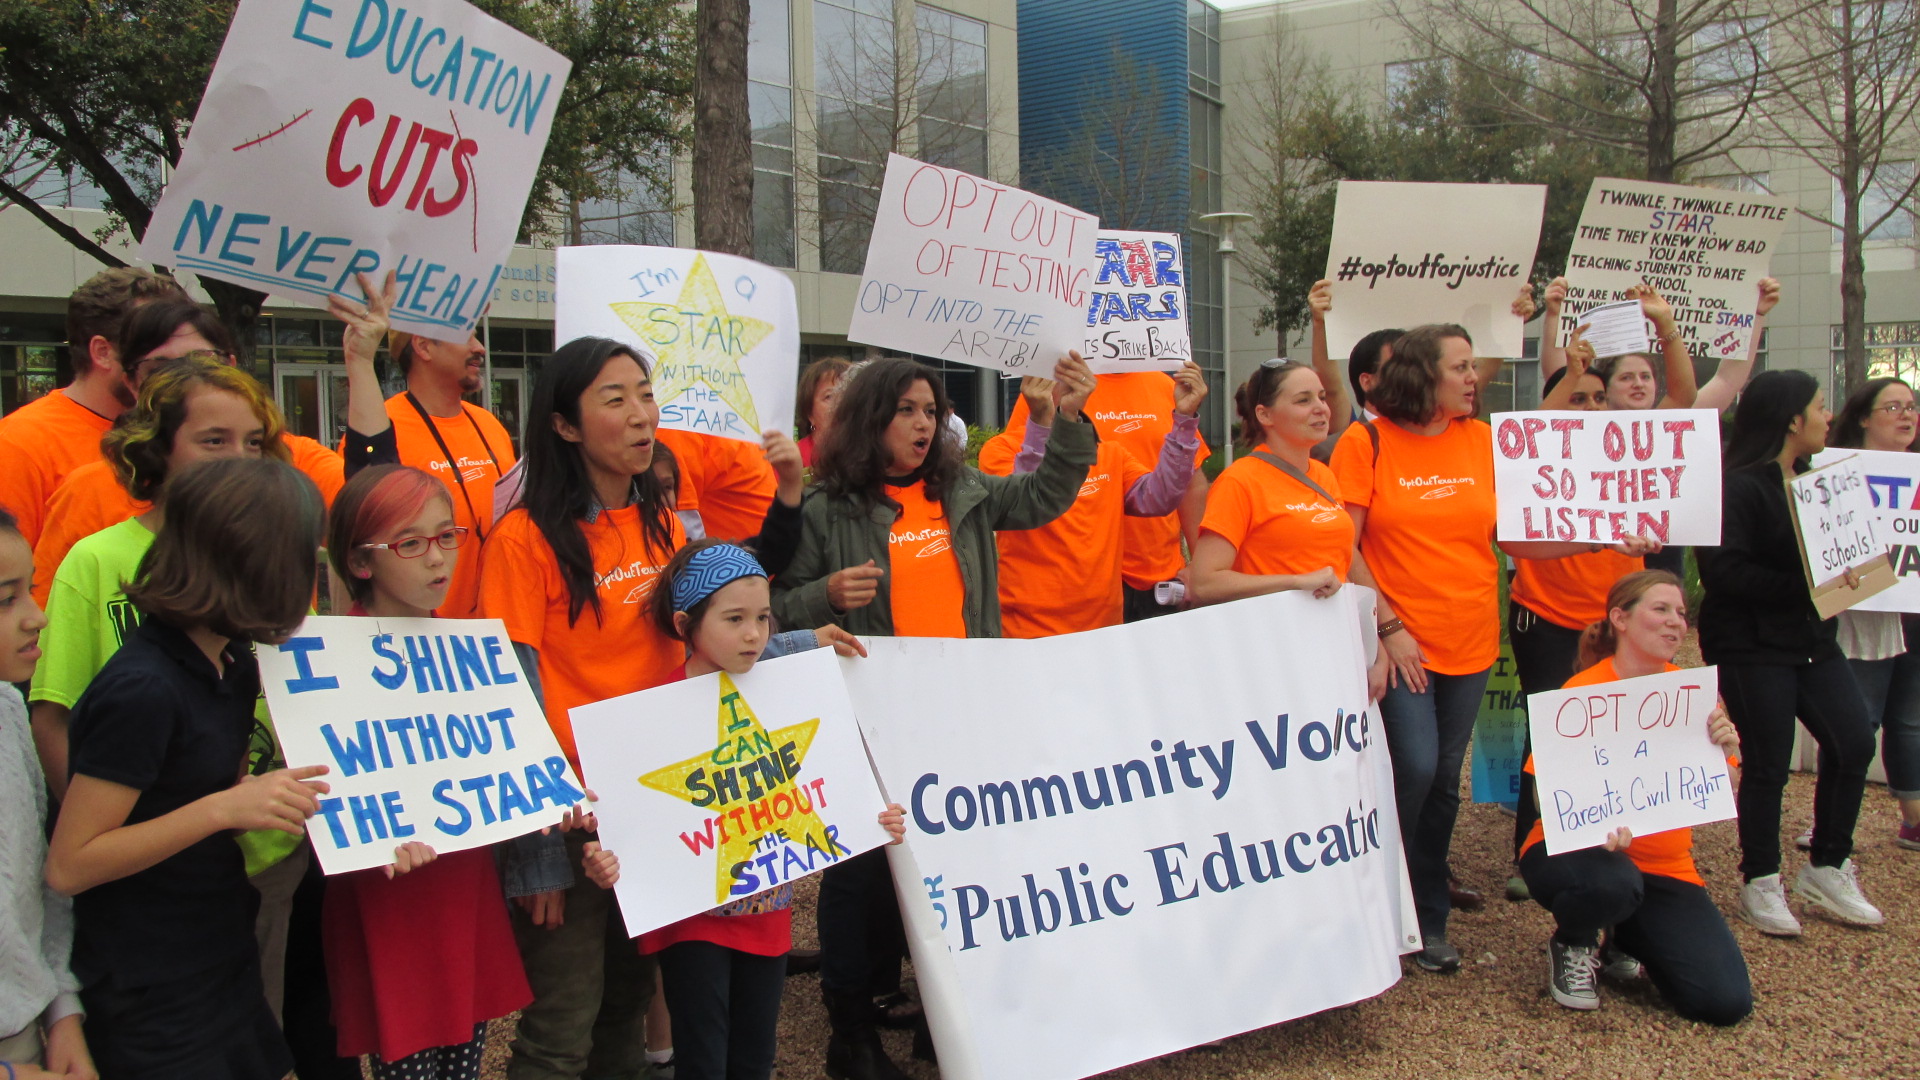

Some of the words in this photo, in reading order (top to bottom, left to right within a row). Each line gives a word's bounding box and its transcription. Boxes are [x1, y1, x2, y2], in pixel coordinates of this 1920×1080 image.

[293, 0, 551, 136] EDUCATION
[326, 97, 478, 218] CUTS
[903, 165, 1007, 234] OPT
[1010, 199, 1087, 258] OUT
[1737, 203, 1788, 221] LITTLE
[1580, 226, 1612, 242] TIME
[1616, 229, 1648, 245] THEY
[1651, 232, 1697, 249] KNEW
[1697, 236, 1734, 251] HOW
[1735, 240, 1767, 255] BAD
[1649, 247, 1677, 262] YOU
[173, 198, 381, 301] NEVER
[395, 254, 502, 331] HEAL!
[629, 267, 679, 299] I'm
[916, 239, 967, 278] OF
[974, 248, 1090, 308] TESTING
[1337, 252, 1520, 290] #optoutforjustice
[1571, 254, 1632, 272] TEACHING
[1634, 260, 1692, 277] STUDENTS
[1697, 265, 1713, 279] TO
[1713, 267, 1747, 282] HATE
[511, 288, 557, 303] SCH
[860, 280, 928, 319] OPT
[925, 296, 983, 324] INTO
[993, 308, 1044, 337] THE
[1563, 300, 1607, 315] TWIN
[1673, 309, 1714, 324] LITTLE
[1715, 312, 1755, 328] STAAR
[1565, 287, 1586, 299] YOU
[1588, 289, 1608, 300] ARE
[1612, 290, 1628, 301] NO
[1662, 294, 1691, 307] SEFUL
[648, 307, 748, 357] STAR
[1102, 331, 1148, 359] STRIKE
[1146, 326, 1190, 358] BACK
[1713, 331, 1735, 347] OPT
[1721, 340, 1741, 356] OUT
[661, 363, 745, 389] WITHOUT
[681, 387, 722, 402] THE
[659, 404, 745, 434] STAAR
[1497, 418, 1584, 459] OPT
[1603, 419, 1696, 462] OUT
[1399, 475, 1475, 490] OptOutTexas.org
[1532, 464, 1577, 501] SO
[1591, 465, 1687, 504] THEY
[1523, 506, 1670, 544] LISTEN
[1820, 517, 1831, 535] to
[1836, 510, 1855, 528] our
[1822, 521, 1878, 571] schools!
[278, 636, 340, 695] I
[371, 634, 519, 694] SHINE
[721, 691, 751, 733] I
[1555, 693, 1627, 738] OPT
[1638, 684, 1701, 731] OUT
[319, 707, 517, 778] WITHOUT
[711, 728, 774, 765] CAN
[1594, 745, 1609, 766] is
[1633, 740, 1648, 759] A
[685, 740, 802, 807] SHINE
[911, 738, 1235, 835] Community
[1630, 771, 1669, 811] Civil
[312, 790, 416, 850] THE
[432, 755, 586, 837] STAAR
[679, 777, 829, 857] WITHOUT
[729, 824, 852, 895] STAAR
[748, 828, 792, 853] THE
[952, 862, 1135, 952] Public
[1143, 798, 1381, 907] Educatio
